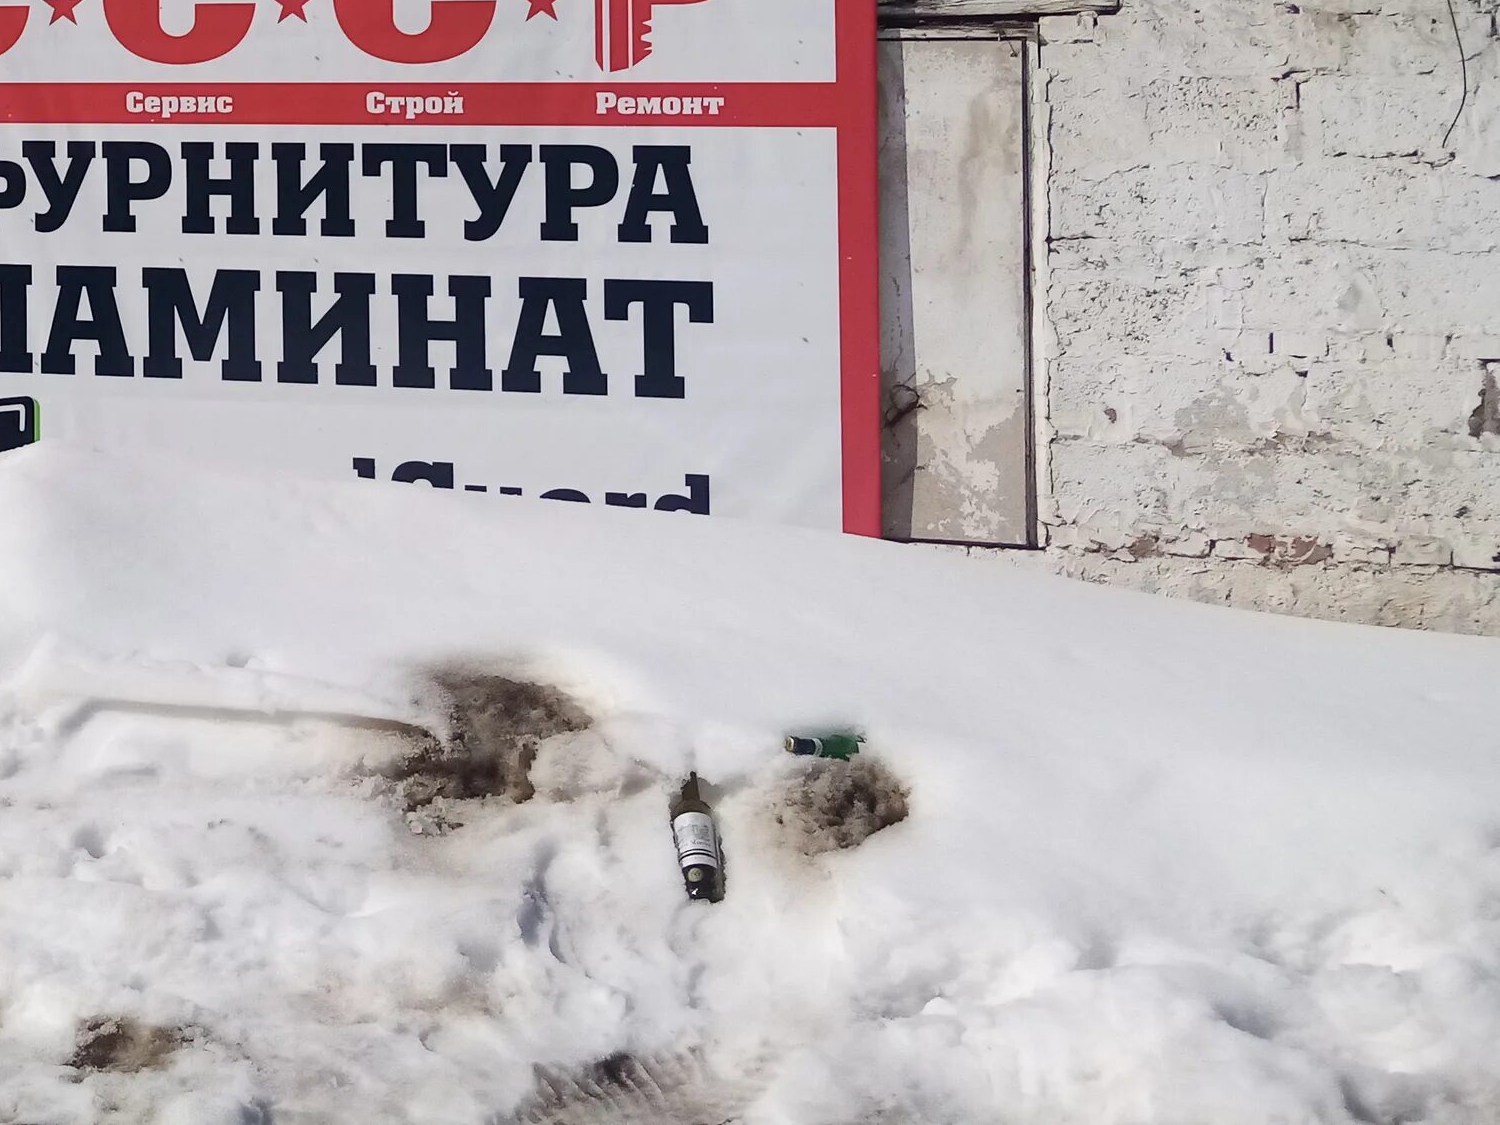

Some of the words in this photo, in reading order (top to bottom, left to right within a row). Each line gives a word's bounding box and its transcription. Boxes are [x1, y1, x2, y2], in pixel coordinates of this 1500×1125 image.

[126, 91, 233, 118] Сервис
[366, 90, 464, 120] Строй
[595, 92, 725, 115] Ремонт
